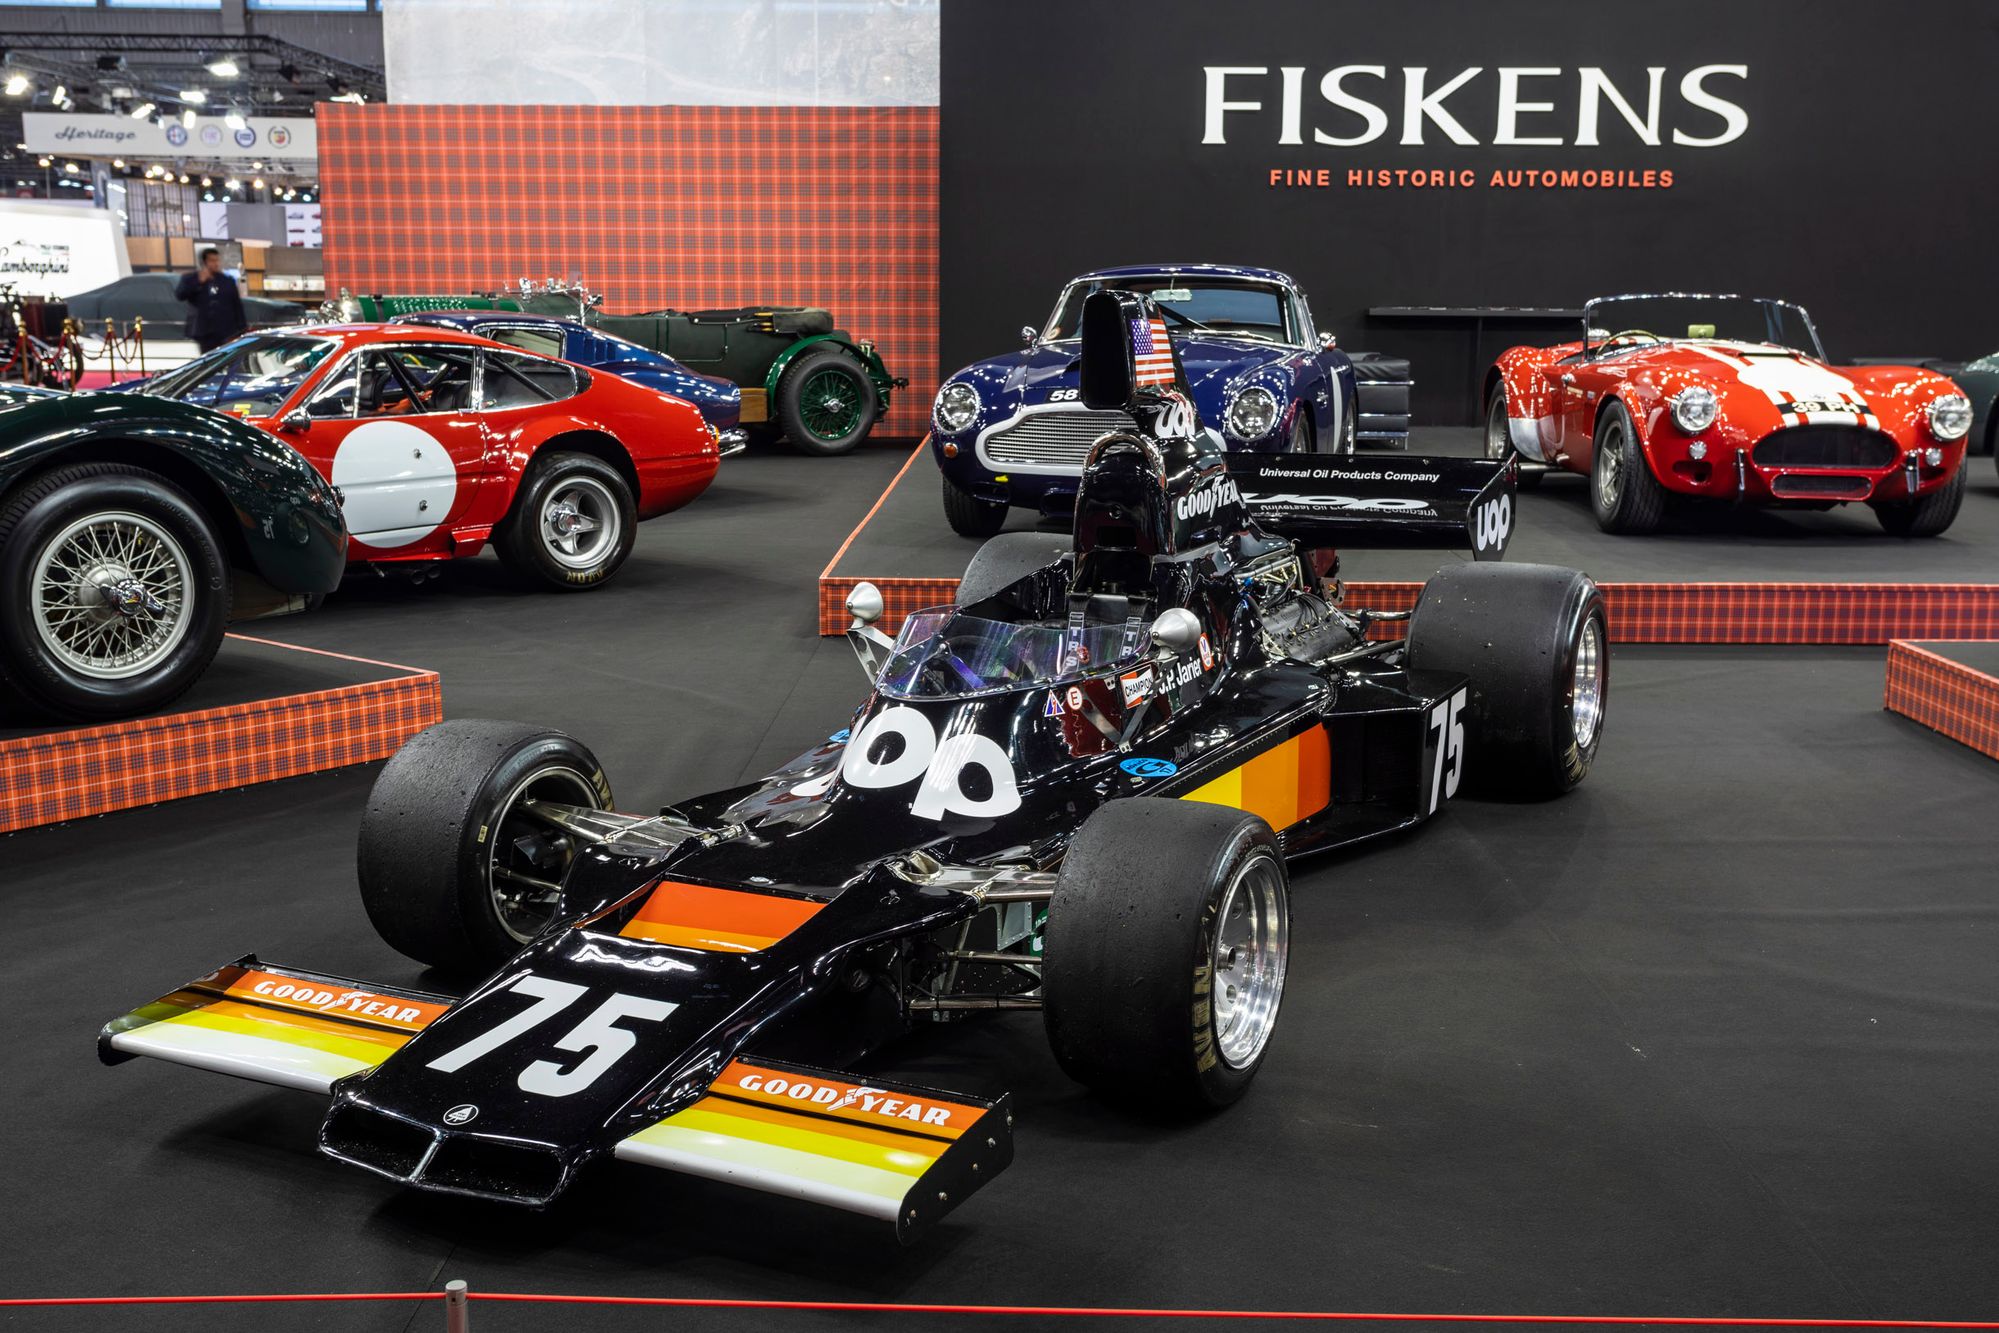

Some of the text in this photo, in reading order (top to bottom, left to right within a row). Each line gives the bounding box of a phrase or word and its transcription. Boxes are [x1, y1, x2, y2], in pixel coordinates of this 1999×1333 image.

[1201, 64, 1749, 147] FISKENS
[55, 126, 136, 143] Heritage
[1270, 169, 1674, 187] FINE HISTORIC AUTOMOBILES
[1259, 468, 1440, 483] Universal Oil Products Company
[1176, 656, 1202, 686] Jarier
[1429, 687, 1467, 815] 75
[425, 975, 680, 1097] 75
